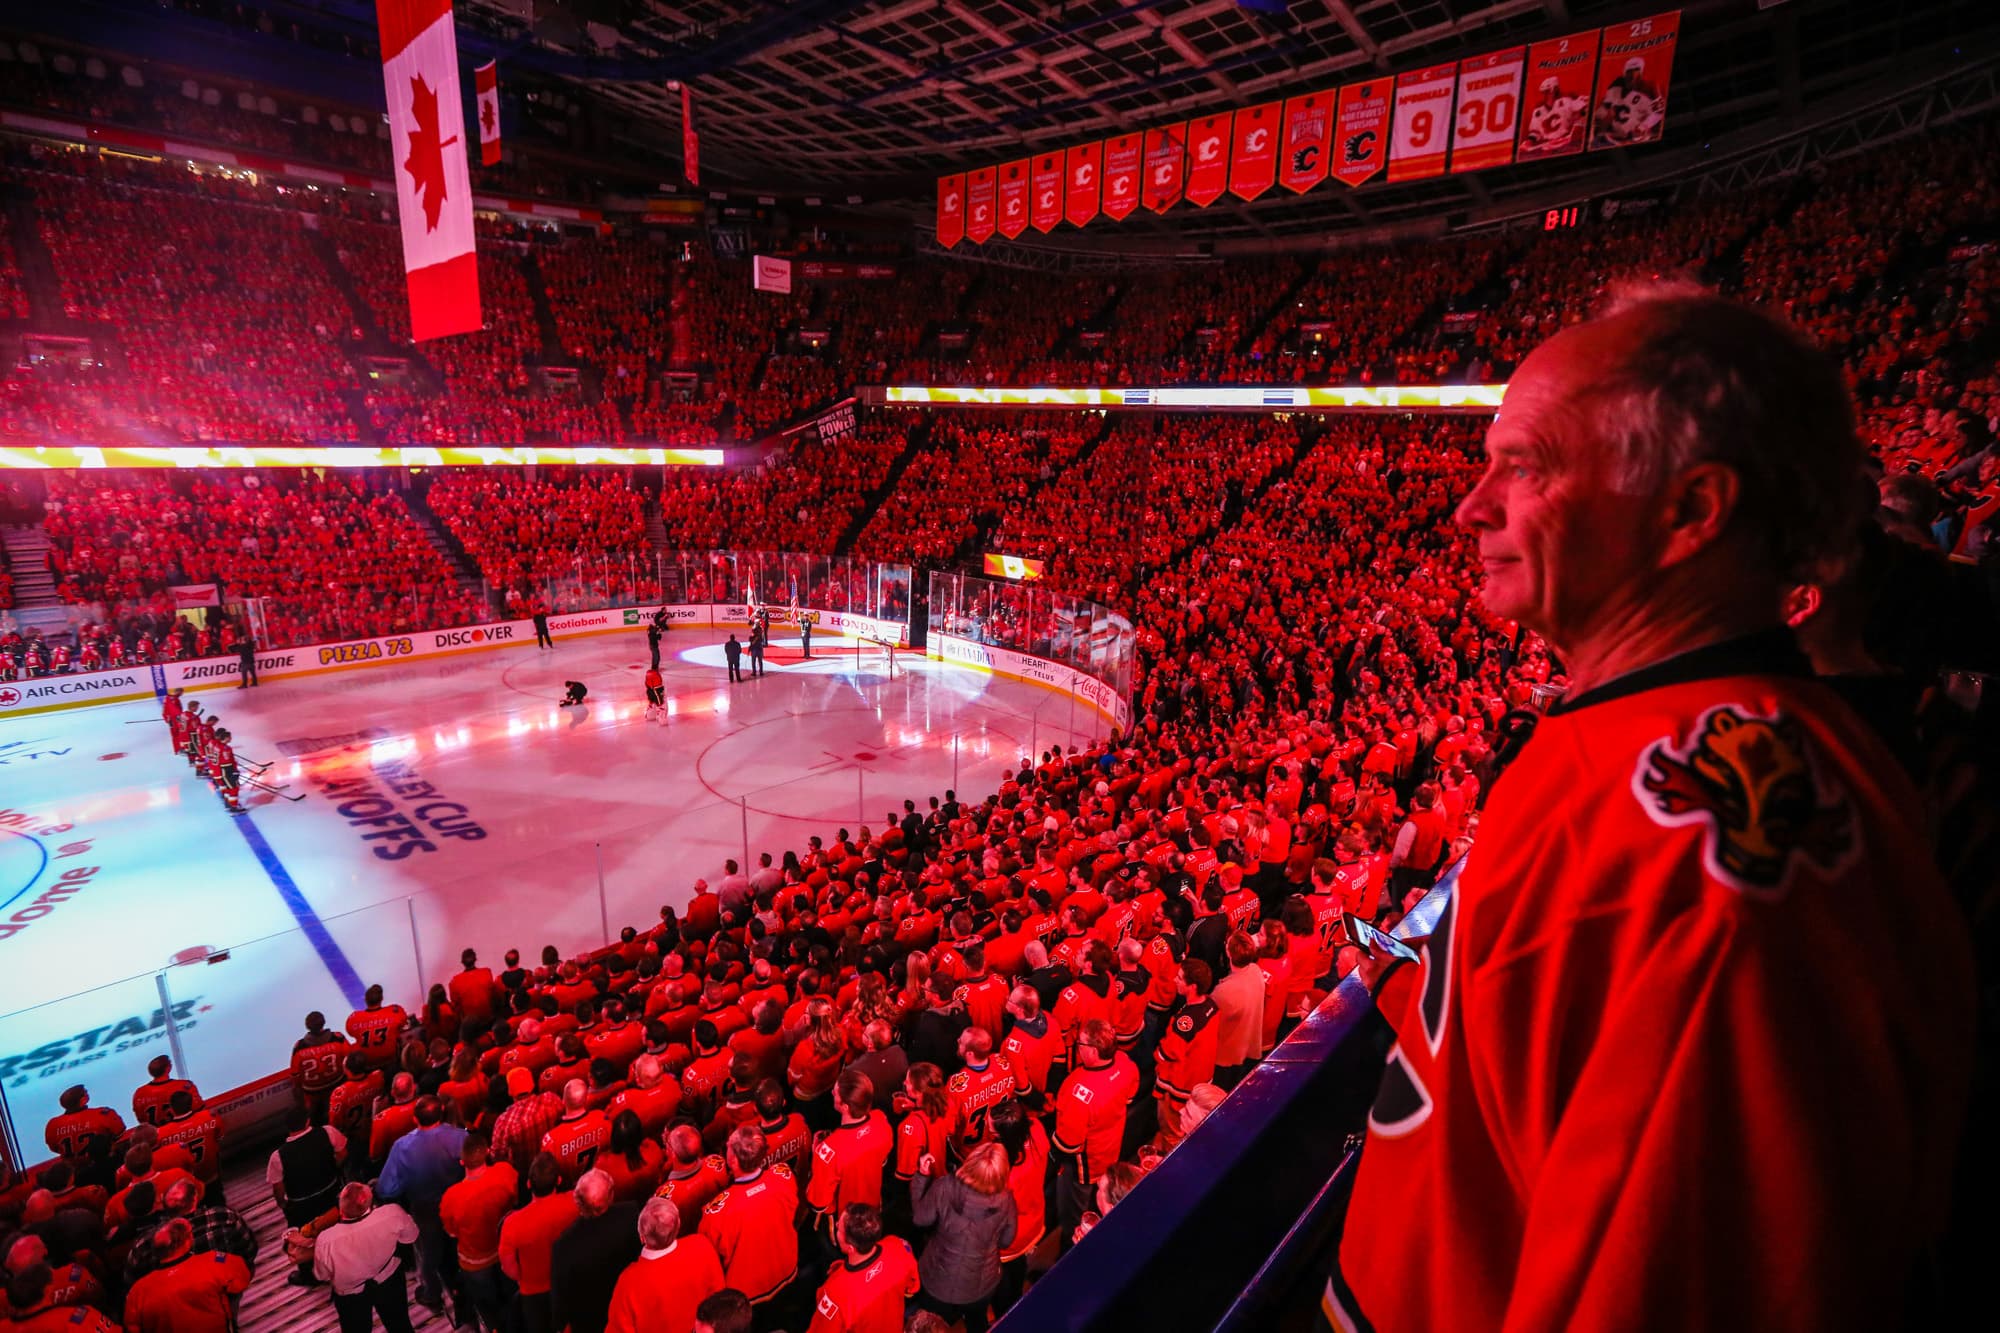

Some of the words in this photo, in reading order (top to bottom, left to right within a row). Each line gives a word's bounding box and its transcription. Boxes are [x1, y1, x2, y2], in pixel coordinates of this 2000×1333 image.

[1631, 20, 1652, 38] 25
[1559, 40, 1569, 53] 2
[1457, 94, 1516, 139] 30
[1409, 110, 1434, 148] 9
[548, 615, 608, 631] Scotiabank
[624, 610, 696, 626] enterise
[830, 616, 878, 634] HONDA
[435, 625, 514, 648] DISCOVER
[318, 641, 384, 665] PIZZA
[385, 637, 414, 656] 73
[182, 655, 295, 680] BRIDGTONE
[1033, 670, 1055, 682] TELUS
[26, 686, 58, 699] AIR
[59, 676, 137, 695] CANADA
[414, 802, 488, 841] CUP
[1317, 906, 1344, 922] IGINLA
[361, 1026, 388, 1048] 13
[39, 1049, 108, 1079] Glass
[115, 1019, 199, 1054] Servce
[302, 1053, 338, 1081] 23
[56, 1121, 91, 1136] IGINLA
[161, 1119, 217, 1146] GIORDANO
[561, 1127, 604, 1156] BRODIE
